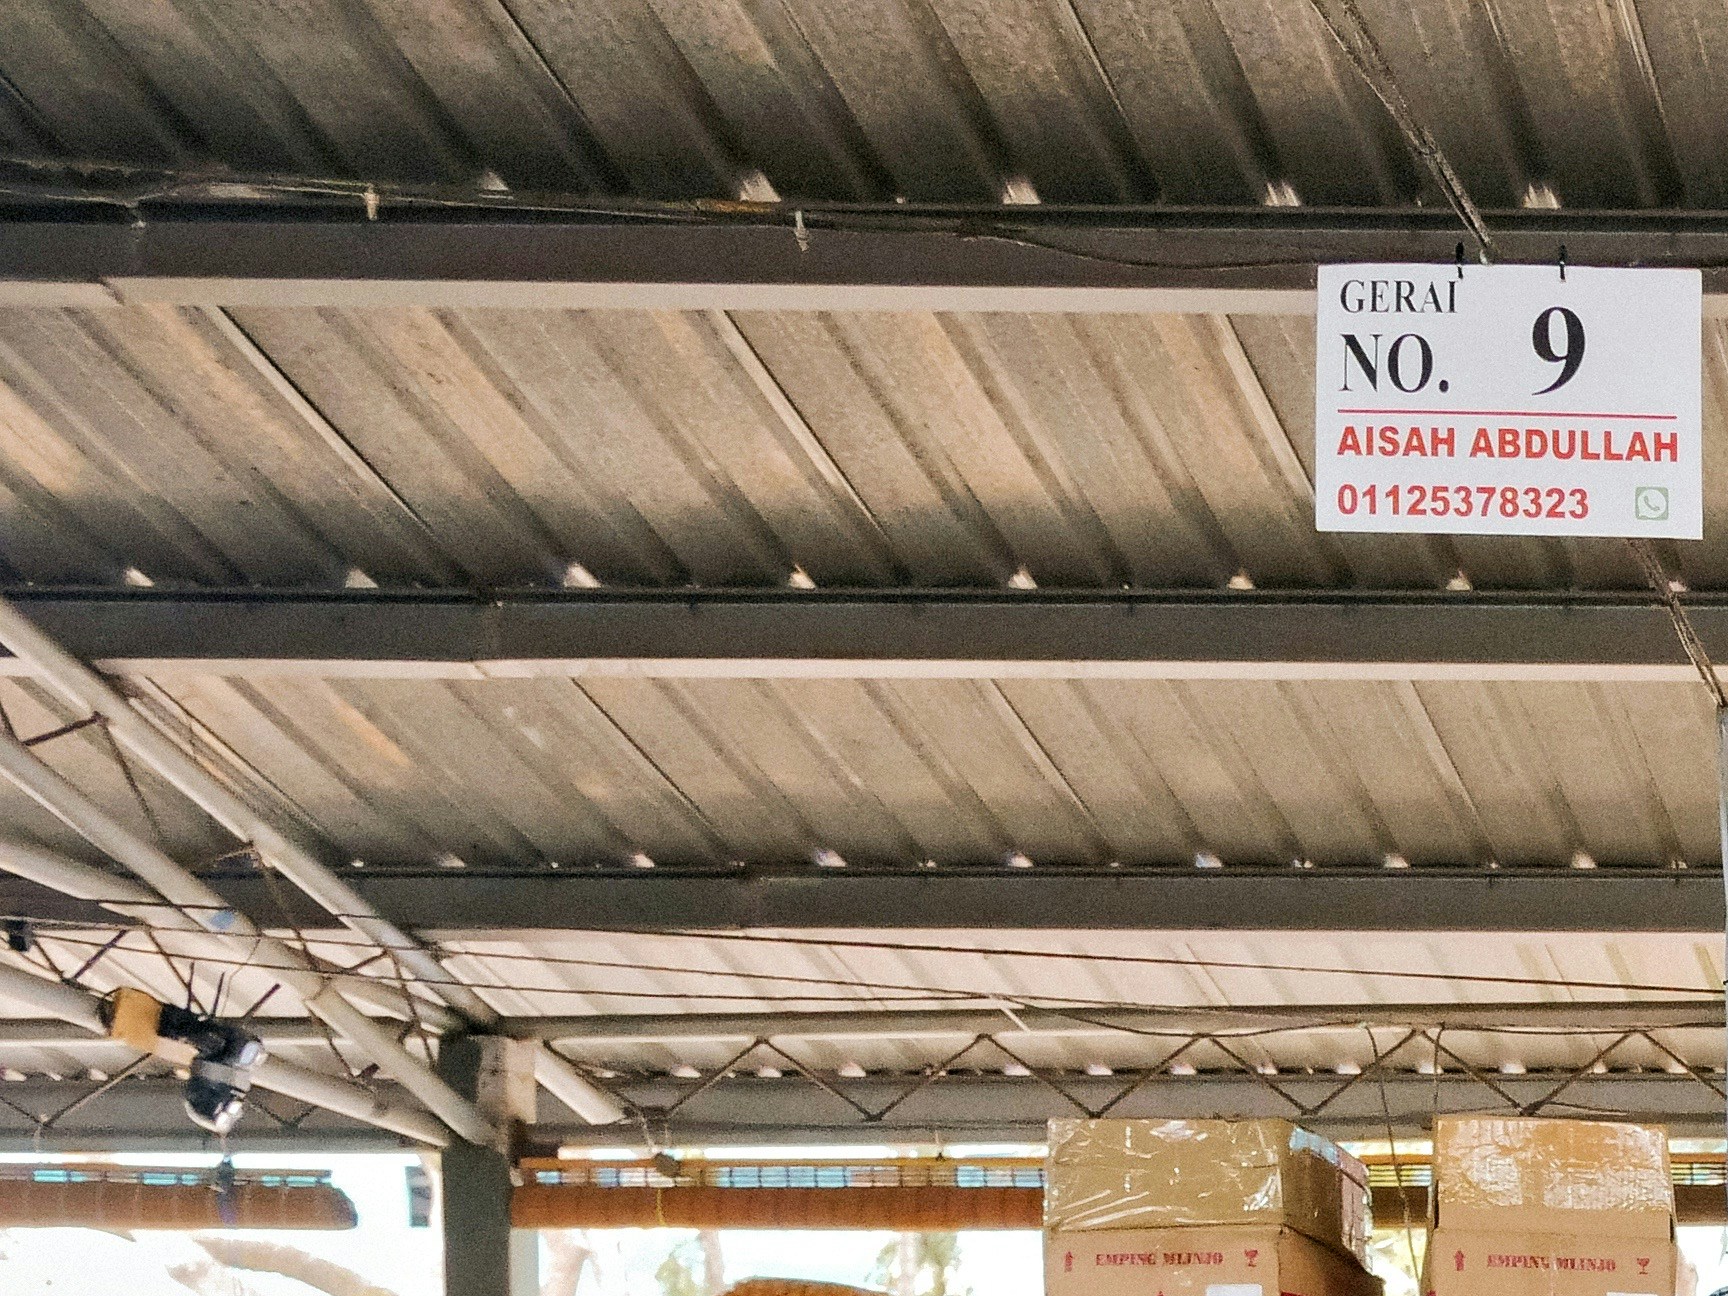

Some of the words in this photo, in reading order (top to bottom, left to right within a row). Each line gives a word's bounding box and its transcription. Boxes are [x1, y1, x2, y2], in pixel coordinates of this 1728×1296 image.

[1340, 280, 1458, 314] GERAI
[1339, 333, 1449, 394] NO.
[1532, 306, 1586, 396] 9
[1337, 425, 1456, 457] AISAH
[1469, 427, 1678, 462] ABDULLAH
[1337, 484, 1589, 519] 01125378323
